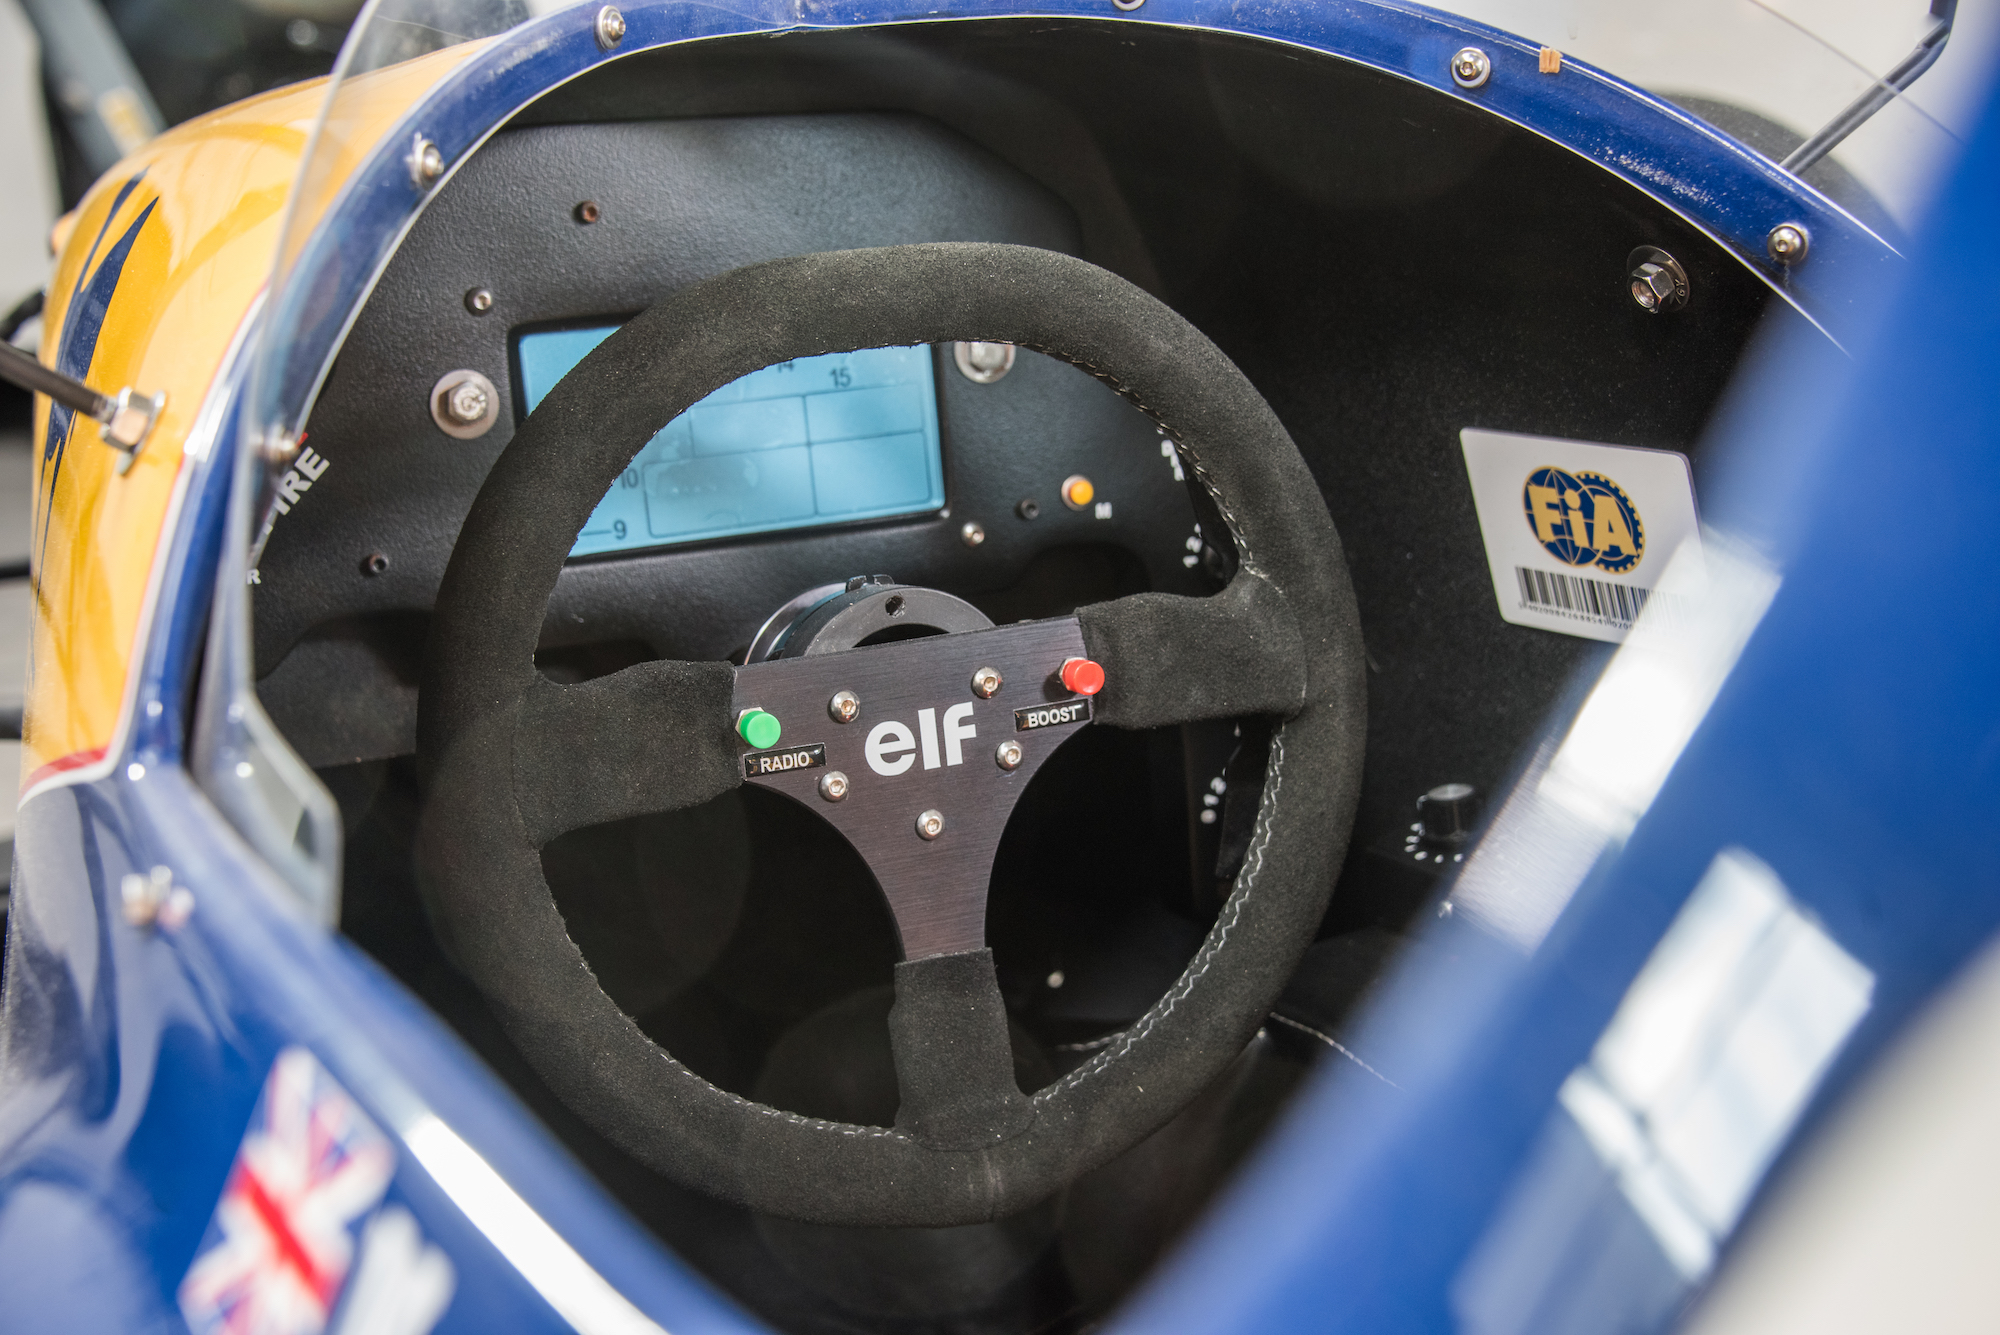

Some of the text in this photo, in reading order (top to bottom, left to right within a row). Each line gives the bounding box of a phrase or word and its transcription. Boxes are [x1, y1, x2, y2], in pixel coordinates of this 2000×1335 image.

[829, 367, 851, 388] 15
[620, 467, 639, 490] 10
[263, 446, 330, 535] IRE
[613, 518, 627, 541] 9
[1027, 705, 1079, 729] BOOST
[864, 701, 977, 777] elf
[760, 751, 811, 774] RADIO
